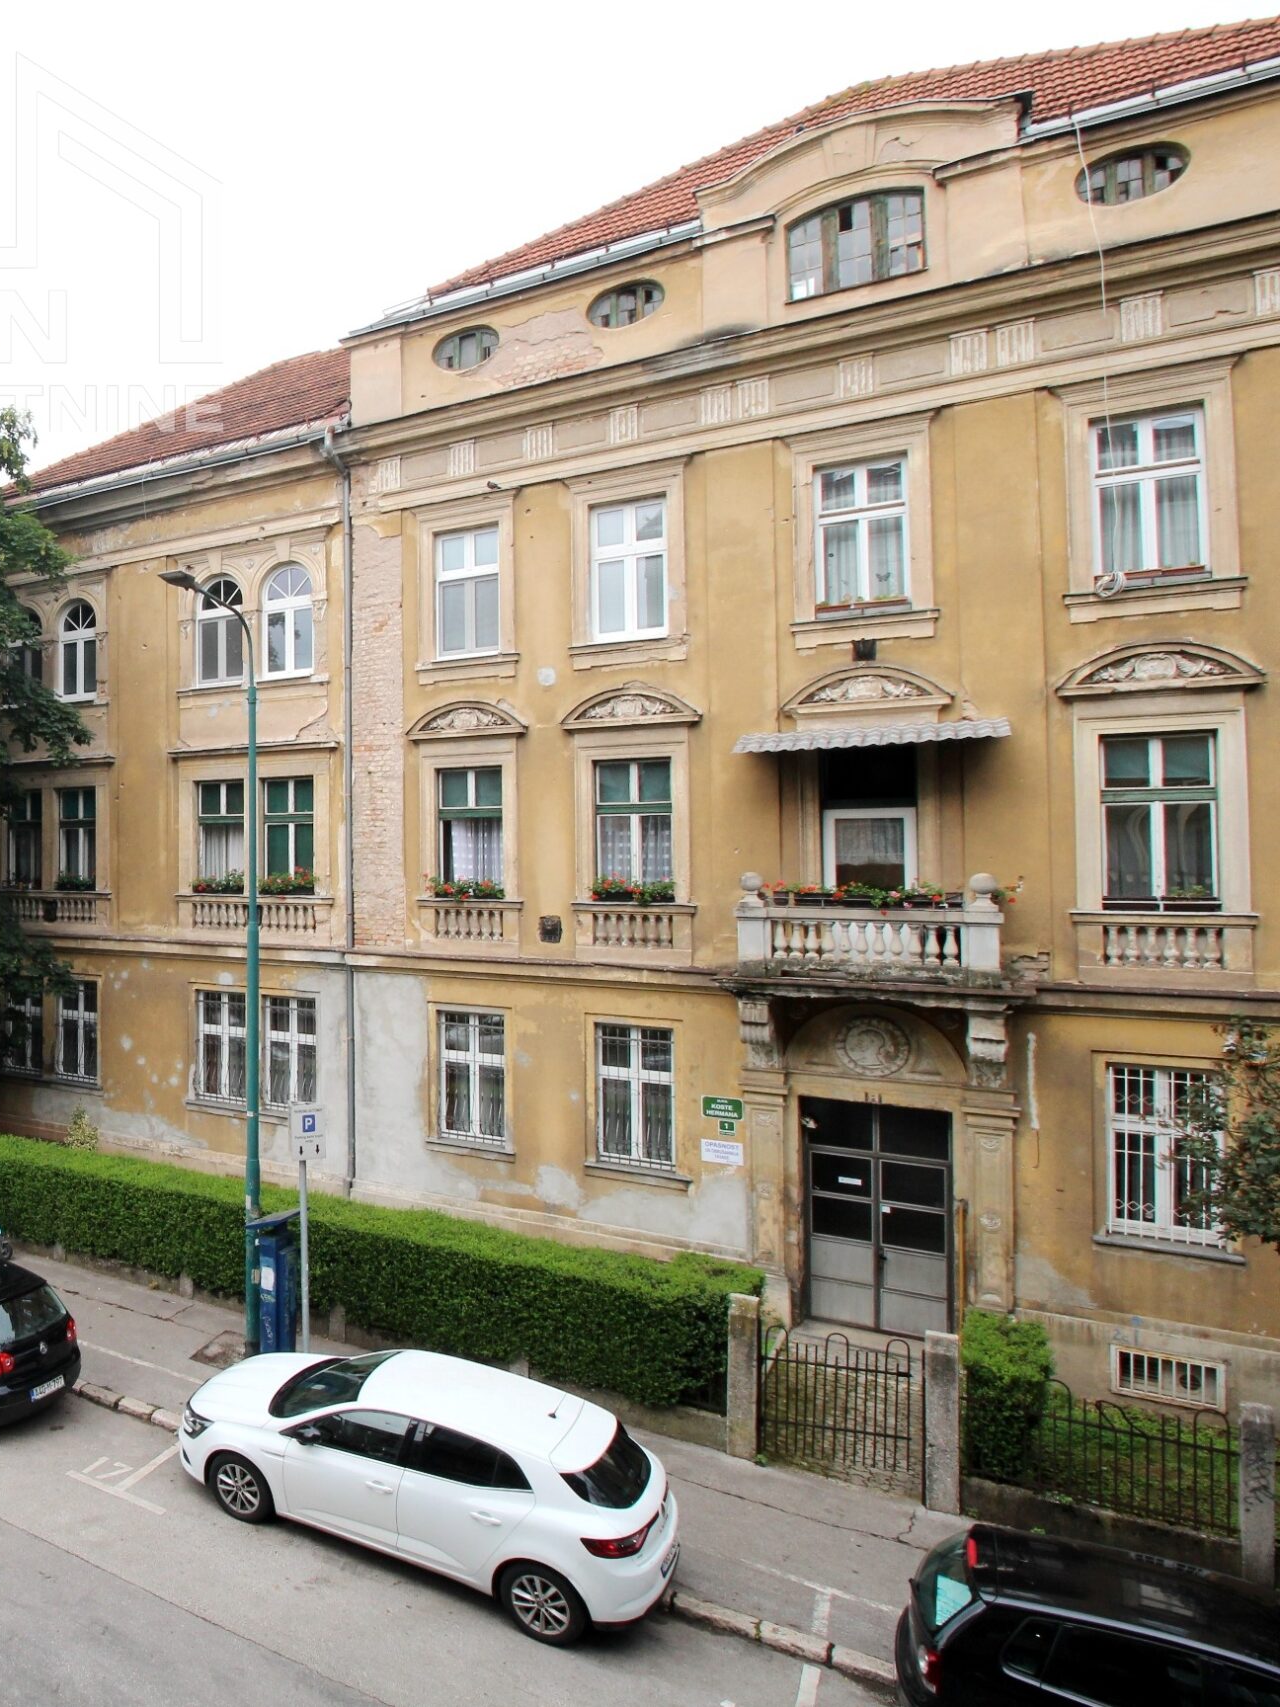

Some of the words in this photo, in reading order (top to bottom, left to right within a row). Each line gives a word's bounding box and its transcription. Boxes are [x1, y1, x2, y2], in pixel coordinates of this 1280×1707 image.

[711, 1103, 733, 1111] KOSTE
[706, 1109, 738, 1118] HERMANA
[304, 1117, 313, 1130] P
[724, 1122, 729, 1130] 1
[704, 1140, 739, 1150] OPASNOST
[82, 1456, 134, 1479] 17
